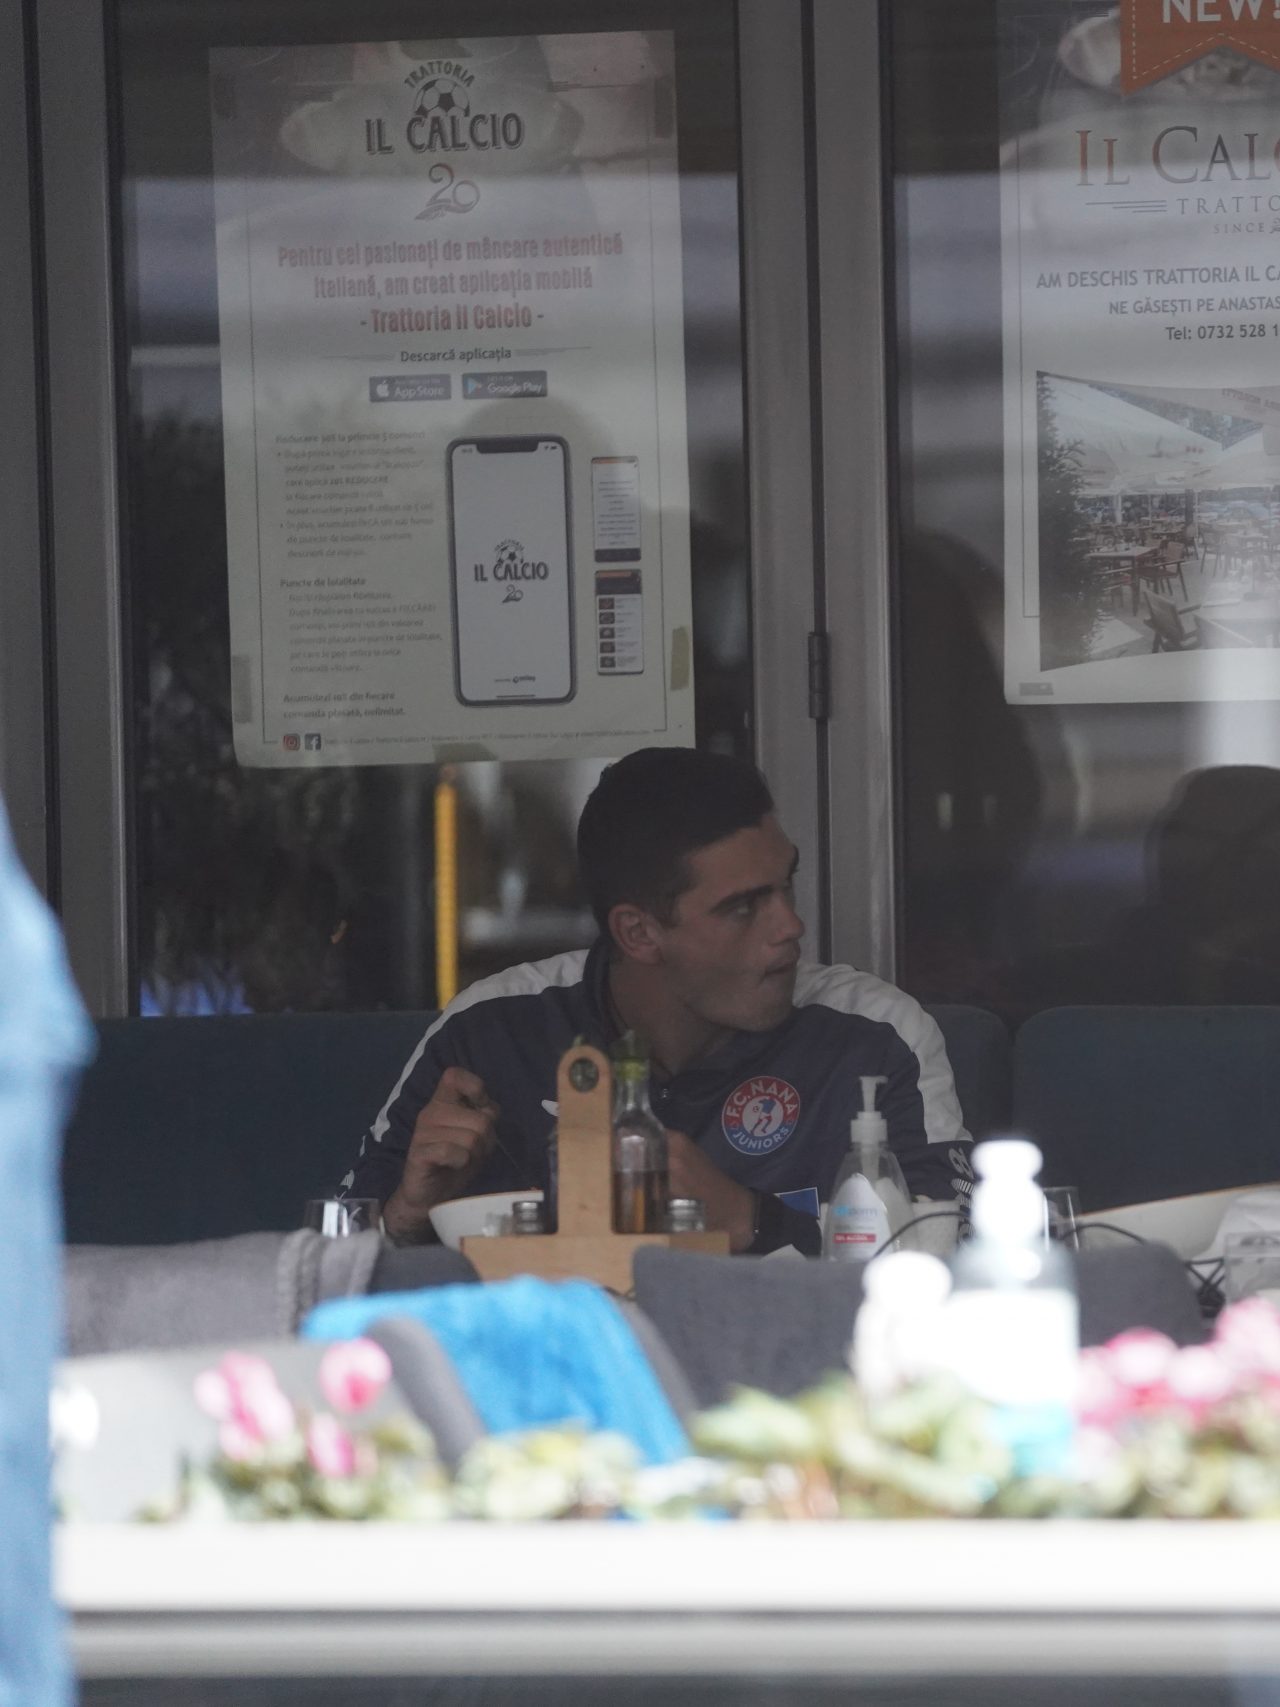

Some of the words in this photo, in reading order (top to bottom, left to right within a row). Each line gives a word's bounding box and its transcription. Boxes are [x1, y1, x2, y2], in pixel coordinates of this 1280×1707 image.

[404, 60, 476, 88] TRATTORIA
[365, 117, 395, 155] IL
[406, 112, 526, 154] CALCIO
[1075, 130, 1130, 186] IL
[1213, 222, 1265, 235] SINCE
[278, 245, 333, 268] Pentru
[336, 242, 361, 266] cei
[442, 238, 463, 262] de
[466, 236, 539, 261] mâncare
[385, 275, 408, 296] am
[413, 272, 456, 295] creat
[536, 265, 594, 291] mobilă
[1036, 272, 1062, 289] AM
[1068, 269, 1139, 288] DESCHIS
[1143, 266, 1241, 286] TRATTORIA
[1245, 265, 1261, 282] IL
[371, 305, 452, 334] Trattoria
[473, 302, 533, 331] Calcio
[1109, 300, 1129, 315] NE
[1197, 298, 1214, 313] PE
[1165, 326, 1193, 341] Tel:
[1197, 325, 1235, 340] 0732
[1239, 324, 1267, 338] 528
[400, 349, 456, 363] Descarcă
[474, 563, 489, 582] IL
[493, 561, 549, 581] CALCIO
[749, 1079, 798, 1115] NANA
[732, 1126, 789, 1150] JUNIORS
